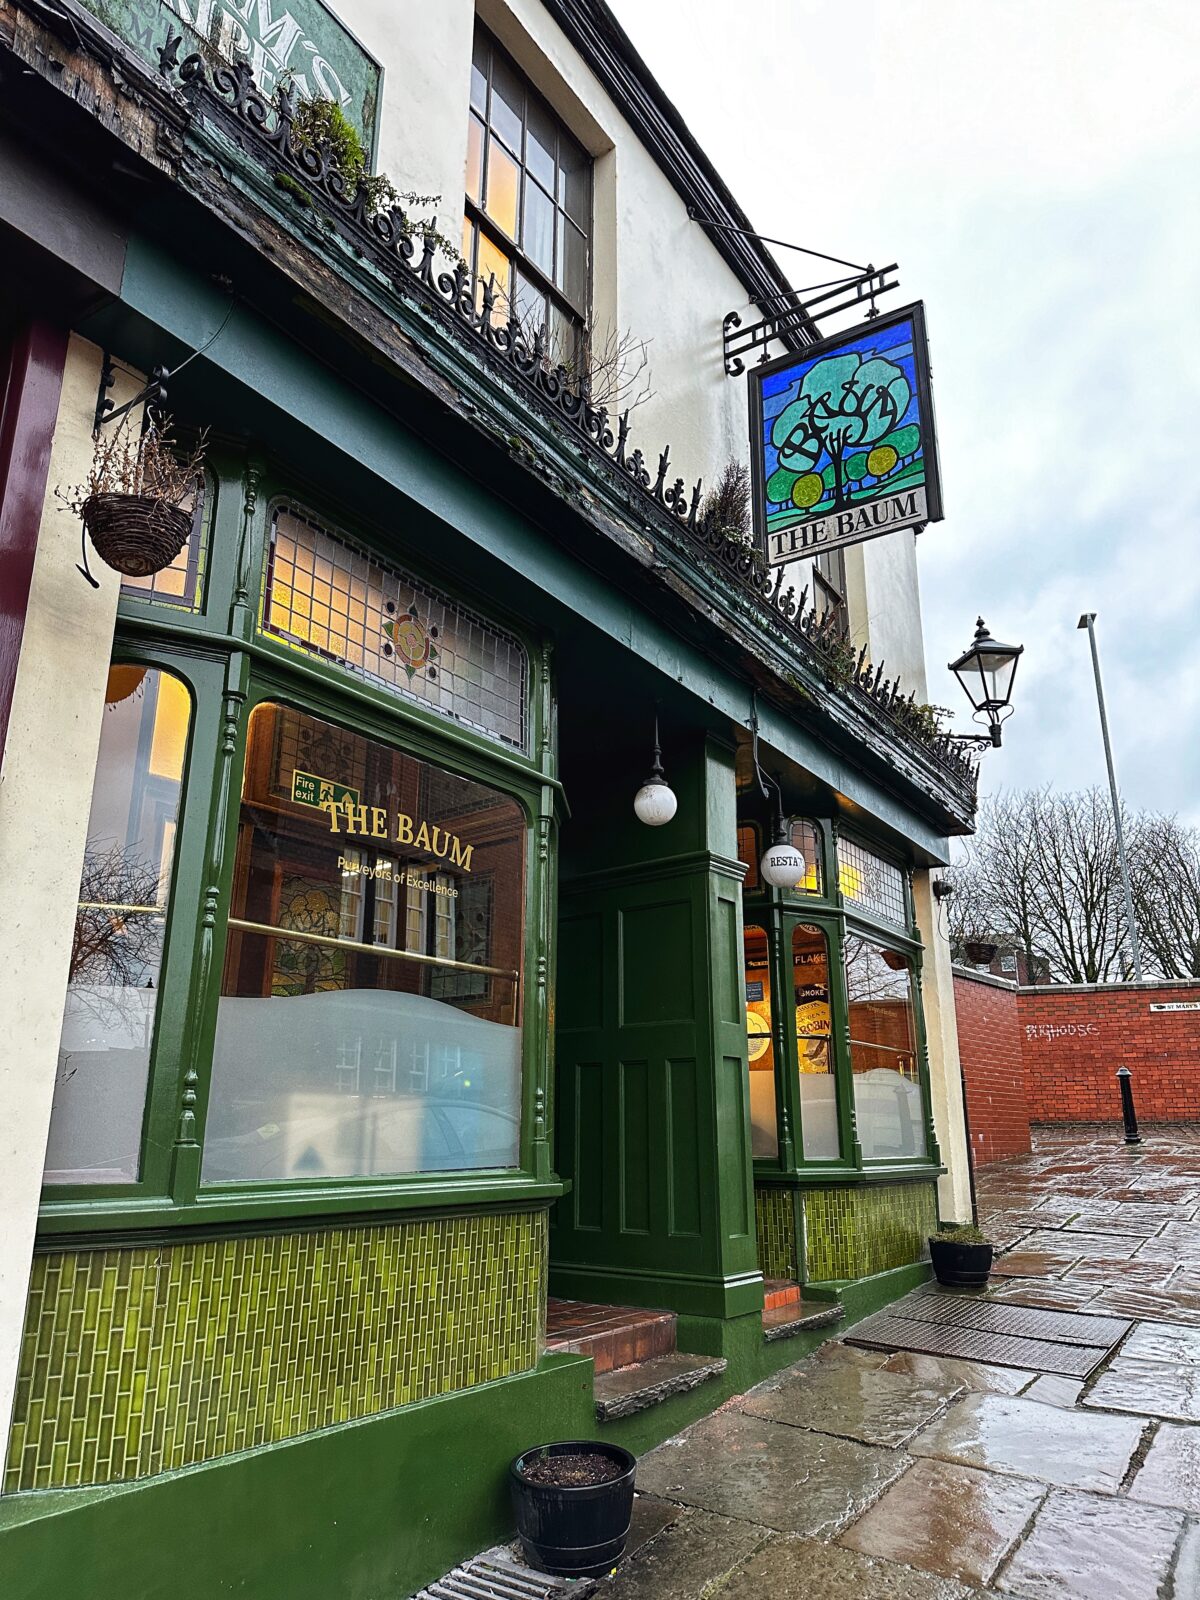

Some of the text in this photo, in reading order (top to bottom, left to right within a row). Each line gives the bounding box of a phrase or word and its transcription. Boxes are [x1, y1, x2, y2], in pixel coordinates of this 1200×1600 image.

[771, 491, 919, 556] THE BAUM
[296, 775, 315, 791] Fire
[295, 790, 314, 802] exit
[320, 800, 475, 872] THE BAUM
[337, 855, 459, 898] Purveyors of Excellence
[795, 953, 827, 964] FLAKE
[799, 1019, 831, 1034] ROBIN
